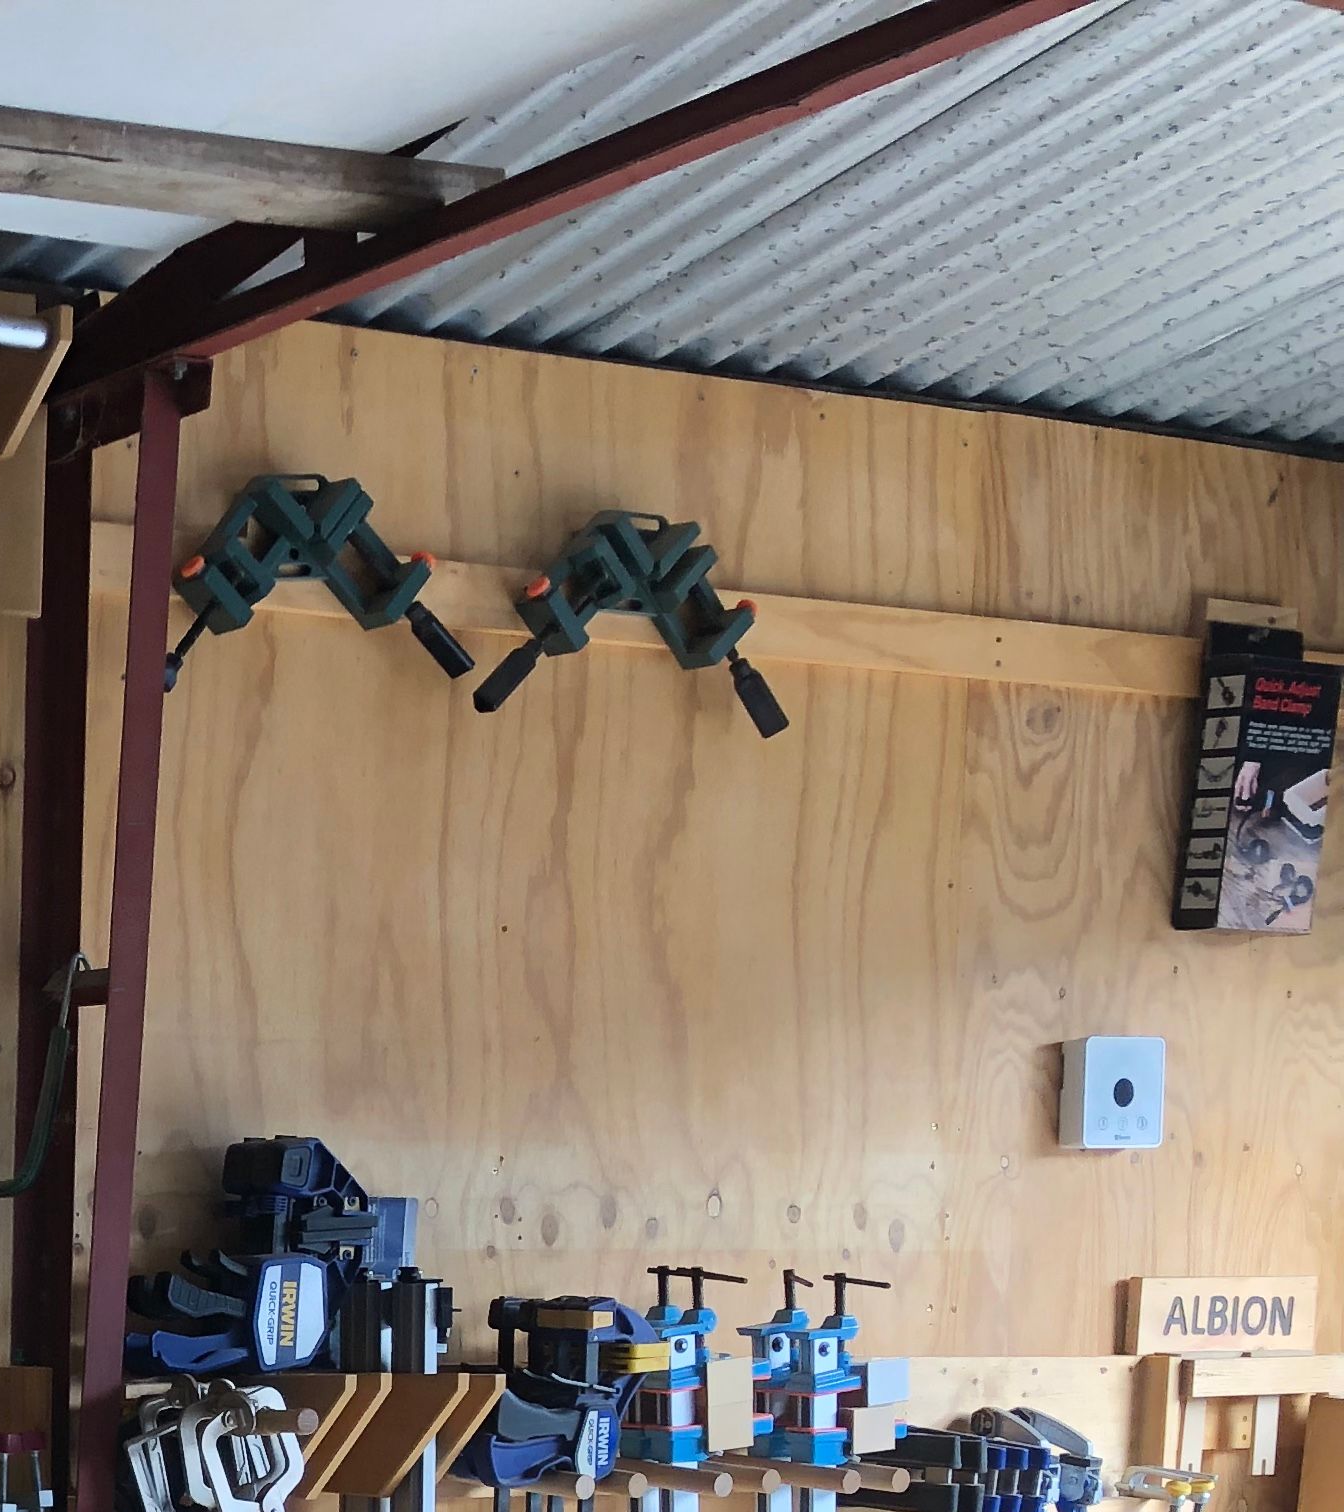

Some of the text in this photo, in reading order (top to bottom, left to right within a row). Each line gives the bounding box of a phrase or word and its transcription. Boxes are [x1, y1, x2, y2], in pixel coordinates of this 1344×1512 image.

[279, 1281, 298, 1347] IRWIN
[1163, 1295, 1295, 1336] ALBION
[597, 1416, 611, 1466] IRWIN
